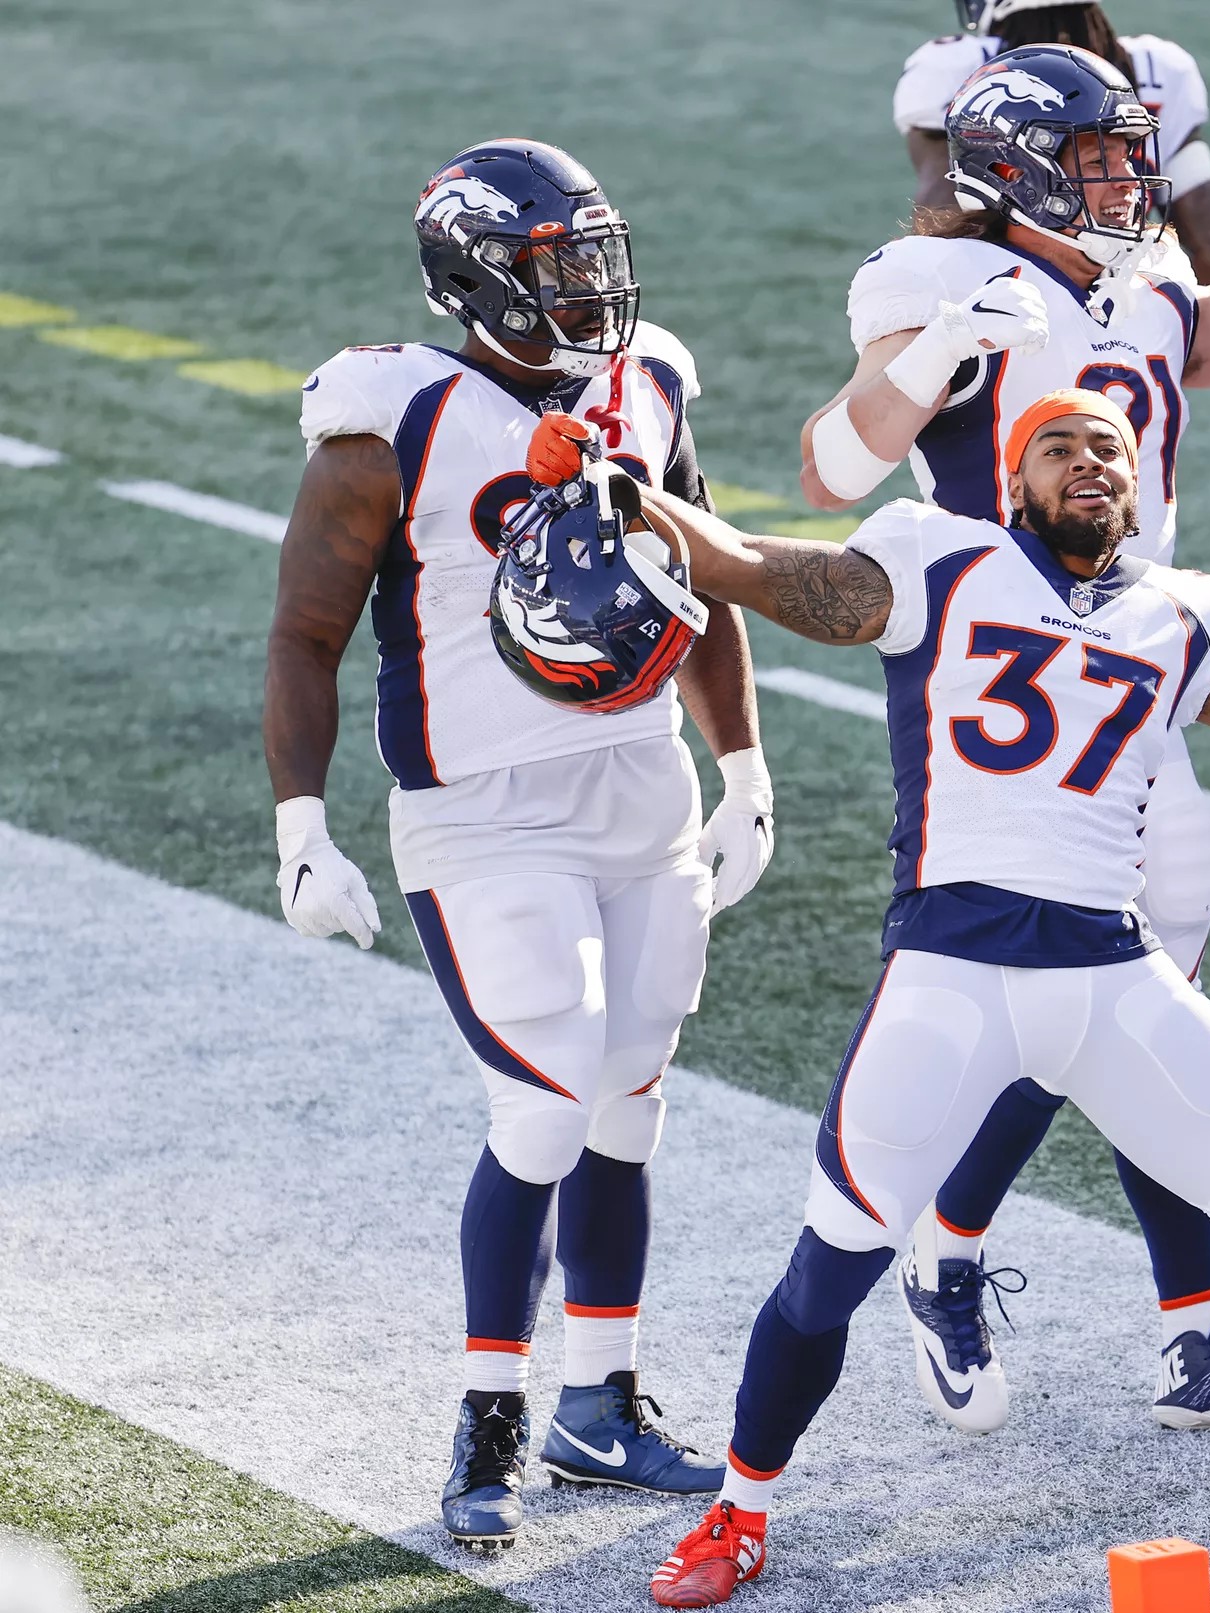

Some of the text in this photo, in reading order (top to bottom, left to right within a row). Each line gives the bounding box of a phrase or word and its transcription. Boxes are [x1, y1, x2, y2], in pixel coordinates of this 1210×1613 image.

[1091, 339, 1139, 354] BRONCOS
[638, 619, 662, 640] 37
[1040, 615, 1112, 641] BRONCOS
[949, 621, 1167, 797] 37
